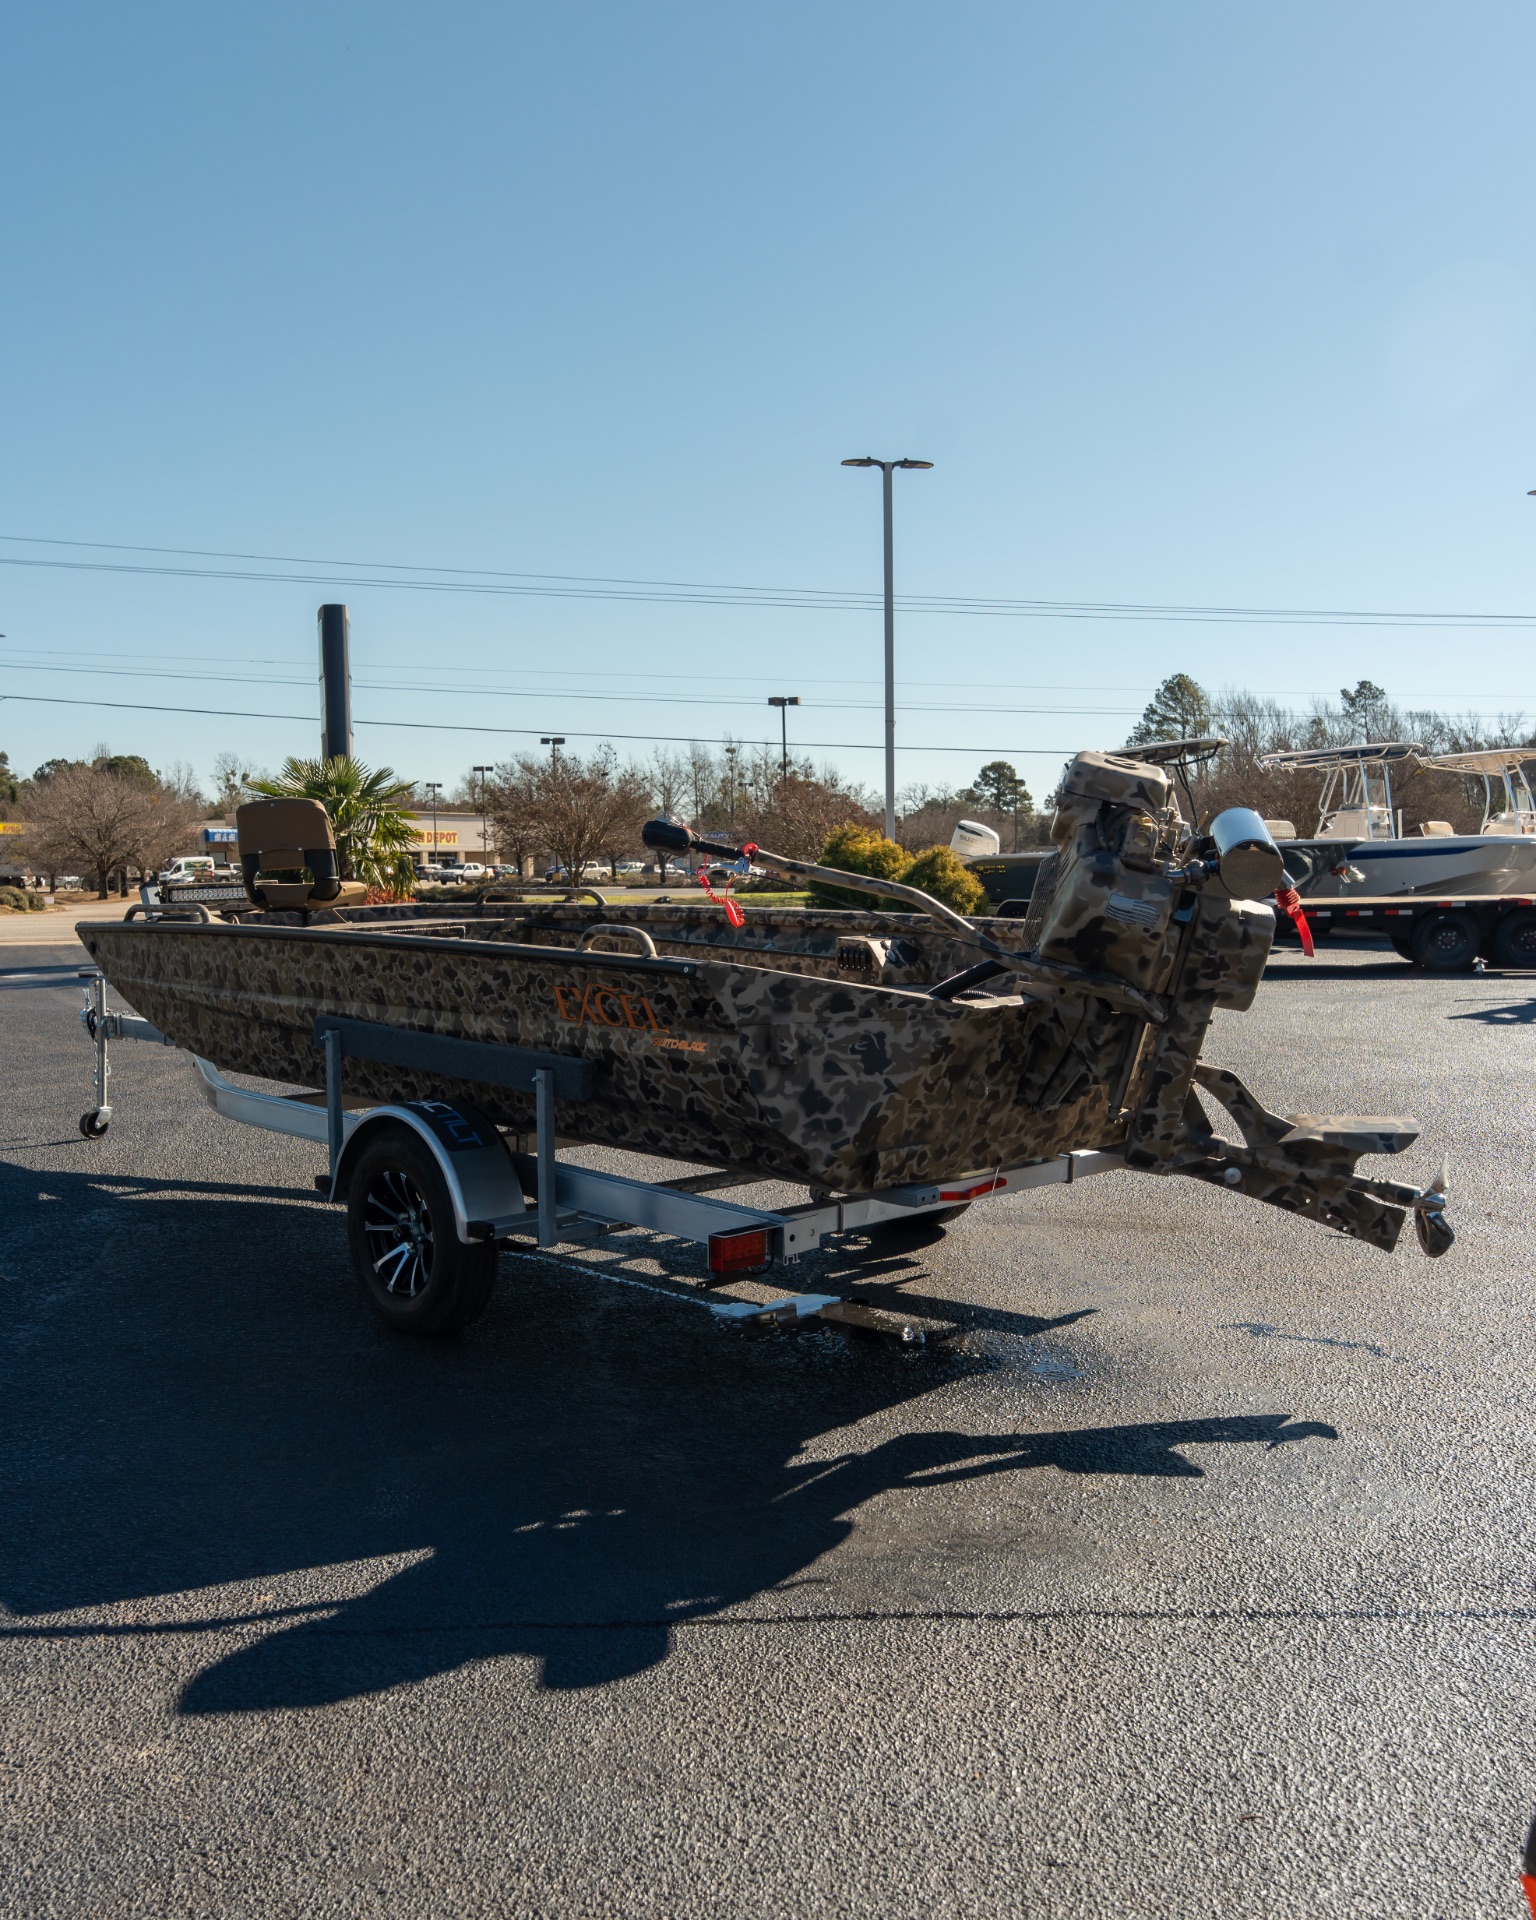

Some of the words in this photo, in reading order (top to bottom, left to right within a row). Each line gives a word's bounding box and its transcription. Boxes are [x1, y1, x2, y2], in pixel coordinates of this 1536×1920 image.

[426, 831, 457, 843] DEPOT
[959, 834, 989, 847] SUZ
[552, 982, 670, 1033] EXCEL
[653, 1037, 707, 1053] SWITCHBLADE
